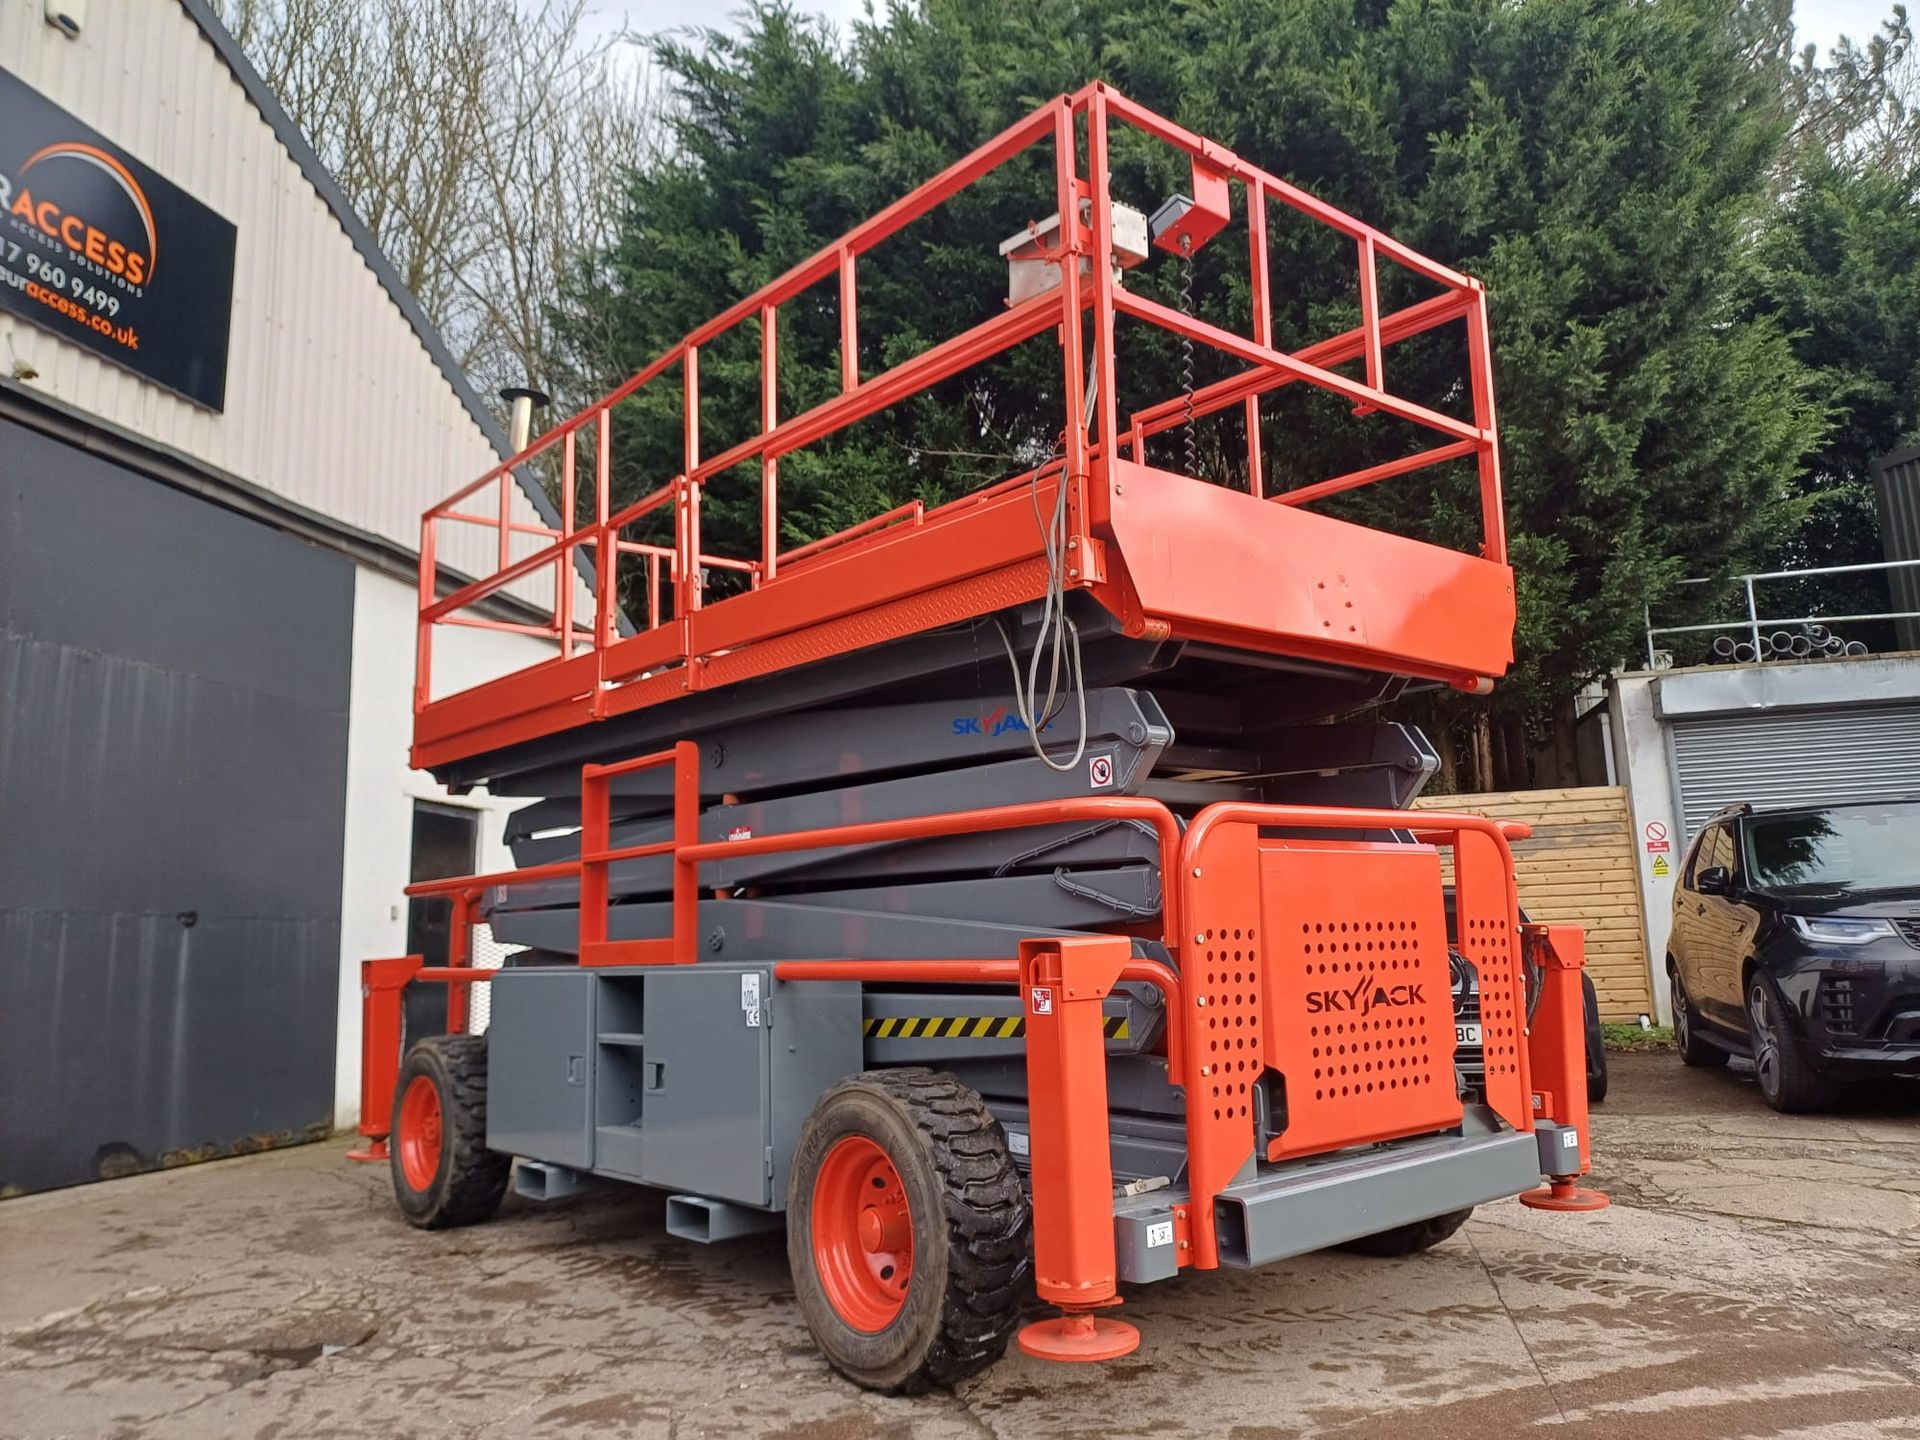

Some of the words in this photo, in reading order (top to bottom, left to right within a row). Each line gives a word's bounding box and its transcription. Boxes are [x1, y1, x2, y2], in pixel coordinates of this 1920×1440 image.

[26, 252, 66, 289] 960
[71, 276, 120, 317] 9499
[68, 250, 143, 299] SOLUTIONS
[1306, 974, 1427, 1017] SKYJACK
